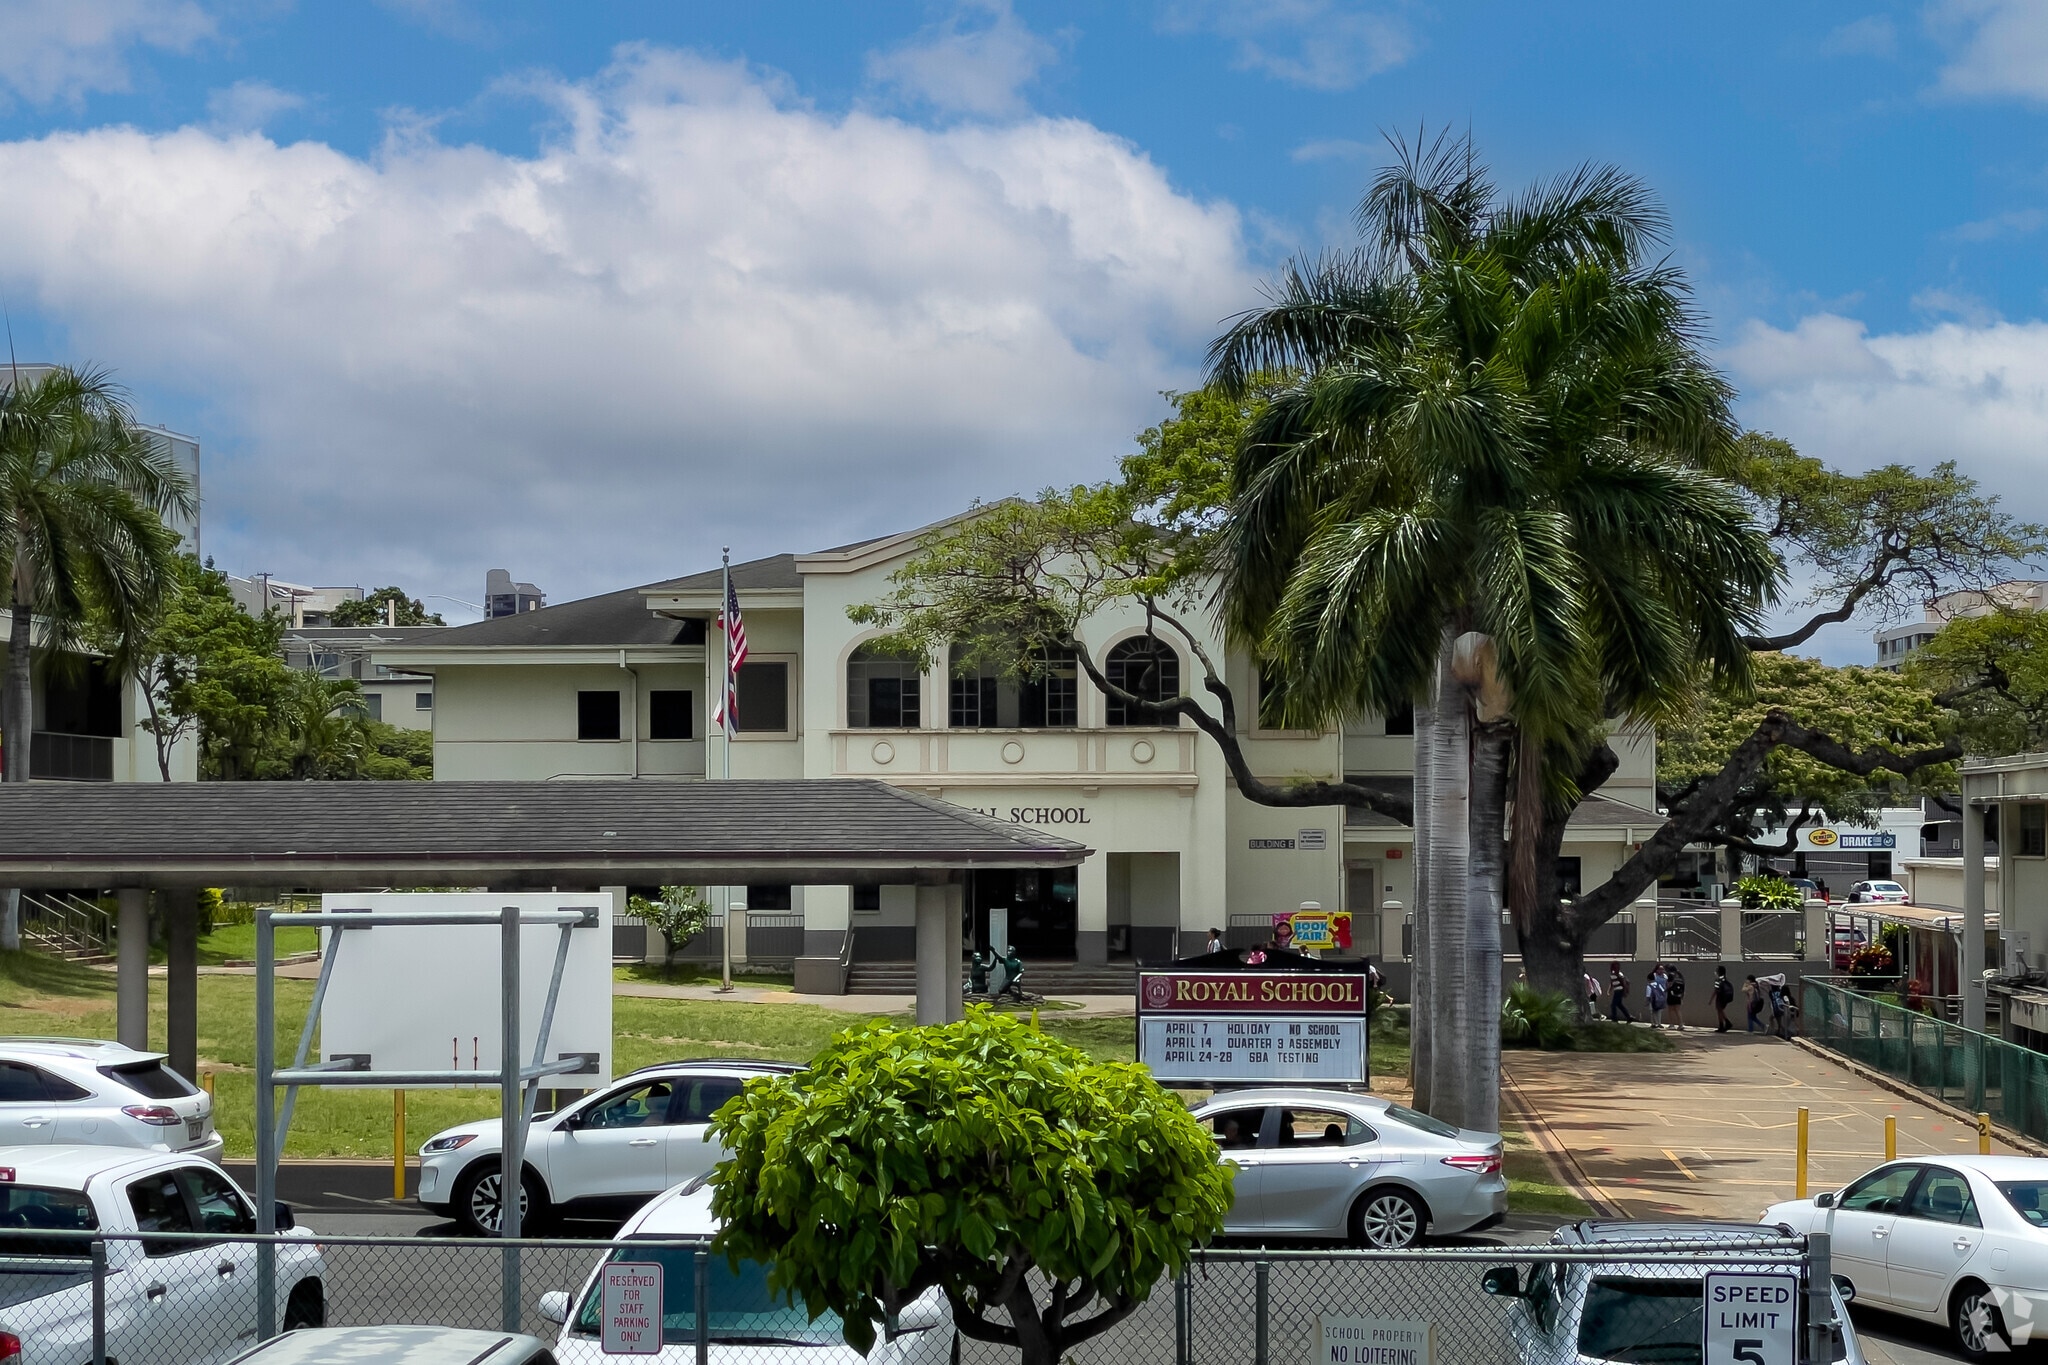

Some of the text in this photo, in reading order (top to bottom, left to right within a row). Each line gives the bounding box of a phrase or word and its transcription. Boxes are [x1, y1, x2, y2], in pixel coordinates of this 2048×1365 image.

[1010, 807, 1091, 824] SCHOOL
[1250, 840, 1294, 848] BUILDING E
[1842, 836, 1873, 847] BRAKE
[1294, 922, 1328, 931] BOOK
[1297, 931, 1327, 941] FAIR!
[1176, 980, 1254, 1001] ROYAL
[1261, 980, 1359, 1002] SCHOOL
[1165, 1023, 1341, 1036] APRIL 7 HOLIDAY NO SCHOOL
[1165, 1037, 1195, 1048] APRIL
[1201, 1037, 1212, 1048] 14
[1277, 1038, 1284, 1049] 3
[1289, 1038, 1341, 1049] ASSEMBLY
[1165, 1051, 1319, 1063] APRIL 24-28 SBA TESTING
[1979, 1123, 1987, 1136] 2
[610, 1276, 655, 1287] RESERVED
[623, 1290, 640, 1300] FOR
[1713, 1286, 1790, 1303] SPEED
[619, 1304, 645, 1314] STAFF
[613, 1317, 650, 1328] PARKING
[1720, 1312, 1780, 1330] LIMIT
[620, 1331, 642, 1342] ONLY
[1325, 1327, 1425, 1343] SCHOOL PROPERTY
[1331, 1345, 1417, 1365] NO LOITERING
[1733, 1339, 1766, 1365] 5
